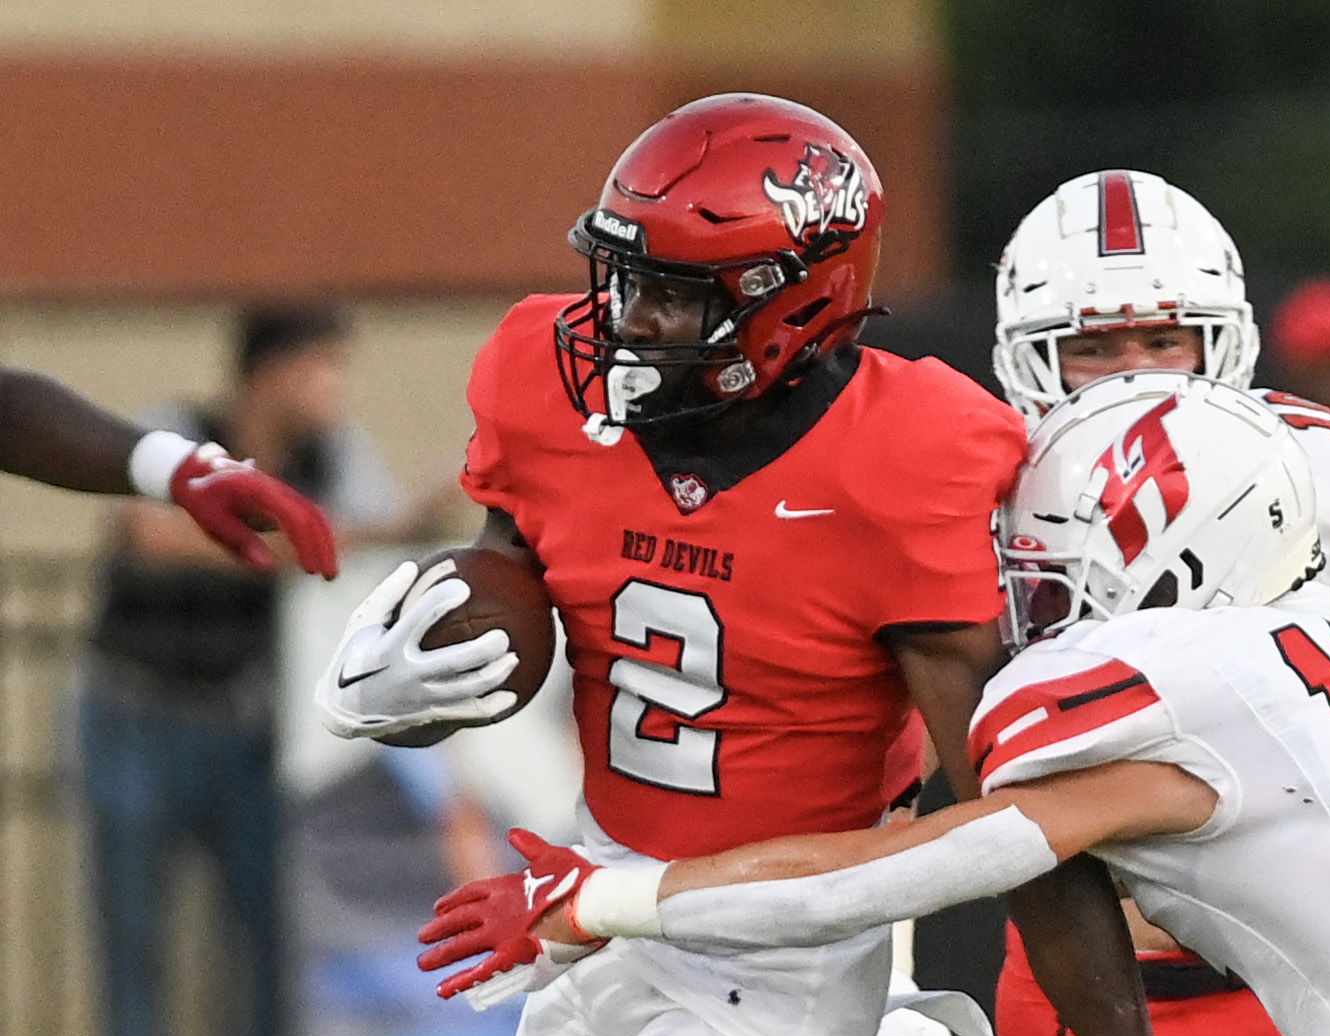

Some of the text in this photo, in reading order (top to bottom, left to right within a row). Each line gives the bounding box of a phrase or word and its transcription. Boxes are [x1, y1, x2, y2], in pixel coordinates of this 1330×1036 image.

[621, 529, 735, 582] RED DEVILS
[608, 576, 729, 798] 2
